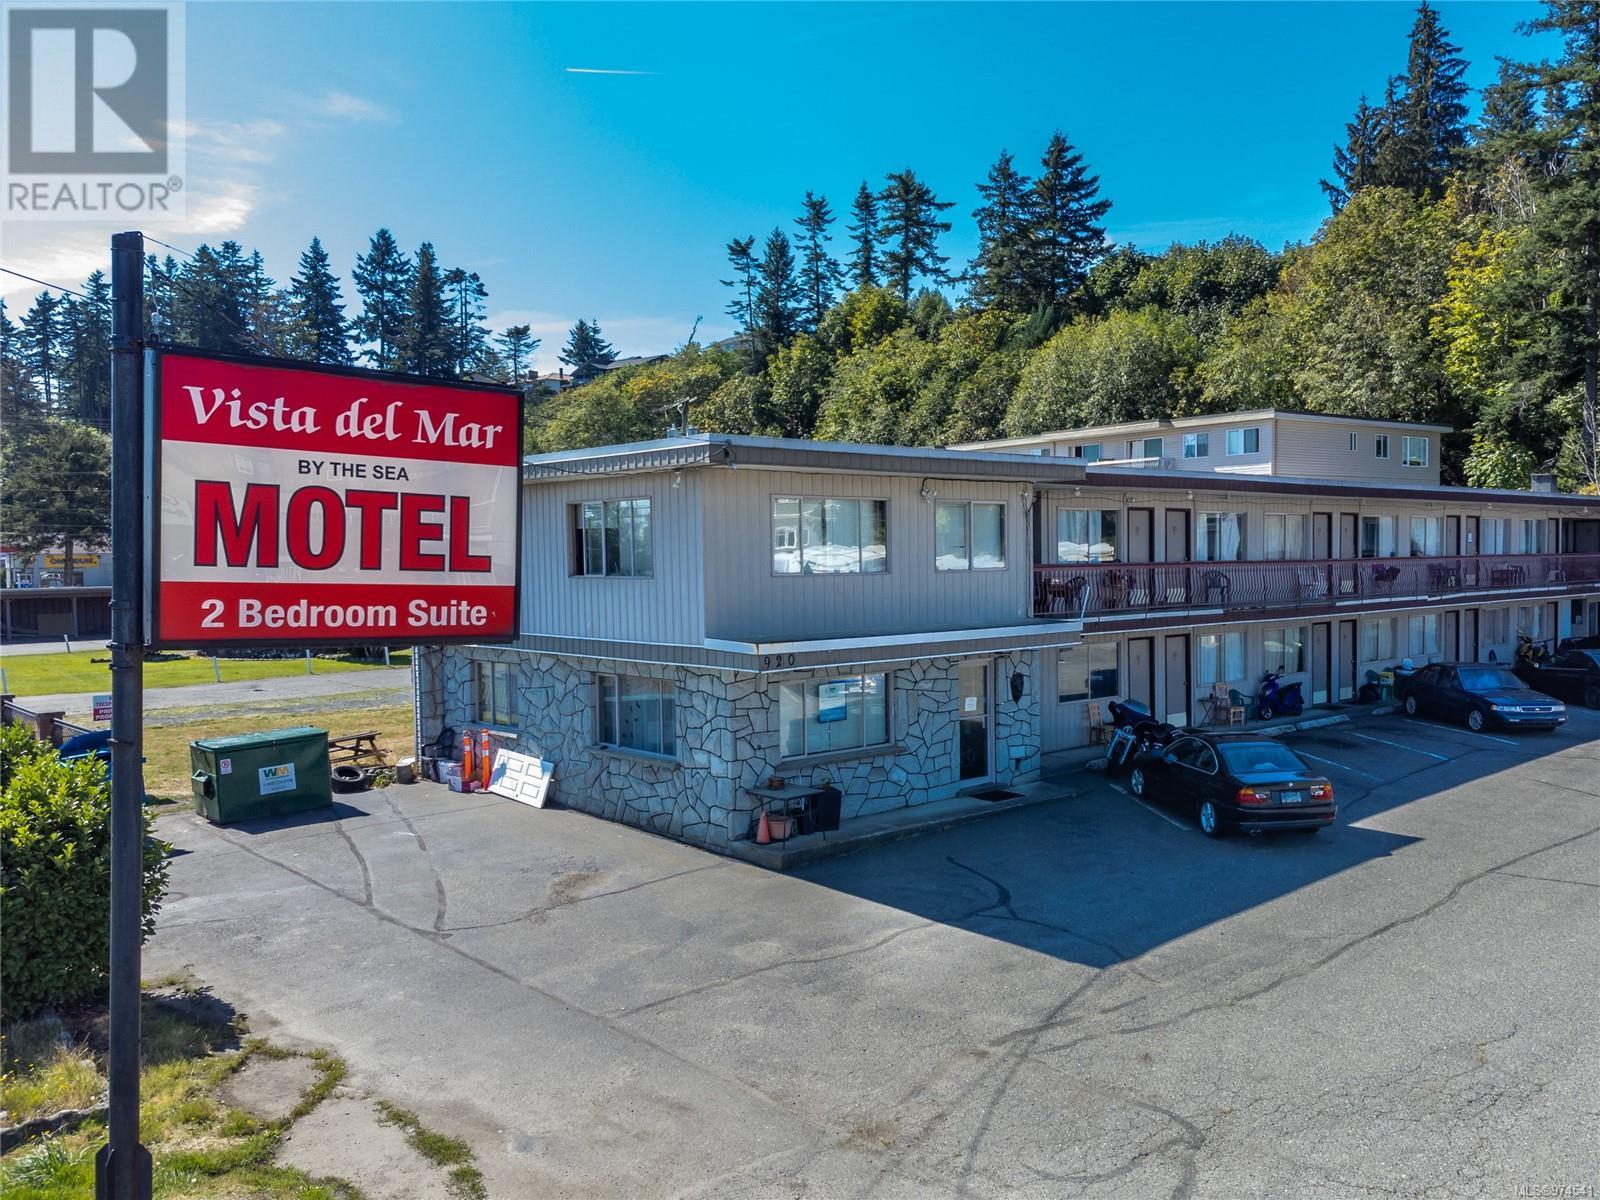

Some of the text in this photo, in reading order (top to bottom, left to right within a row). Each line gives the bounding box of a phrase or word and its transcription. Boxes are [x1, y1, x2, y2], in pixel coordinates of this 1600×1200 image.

[182, 385, 503, 449] Vista del Mar
[298, 459, 409, 481] BY THE SEA
[193, 479, 492, 573] MOTEL
[201, 599, 488, 628] 2 Bedroom Suite
[764, 654, 795, 669] 920
